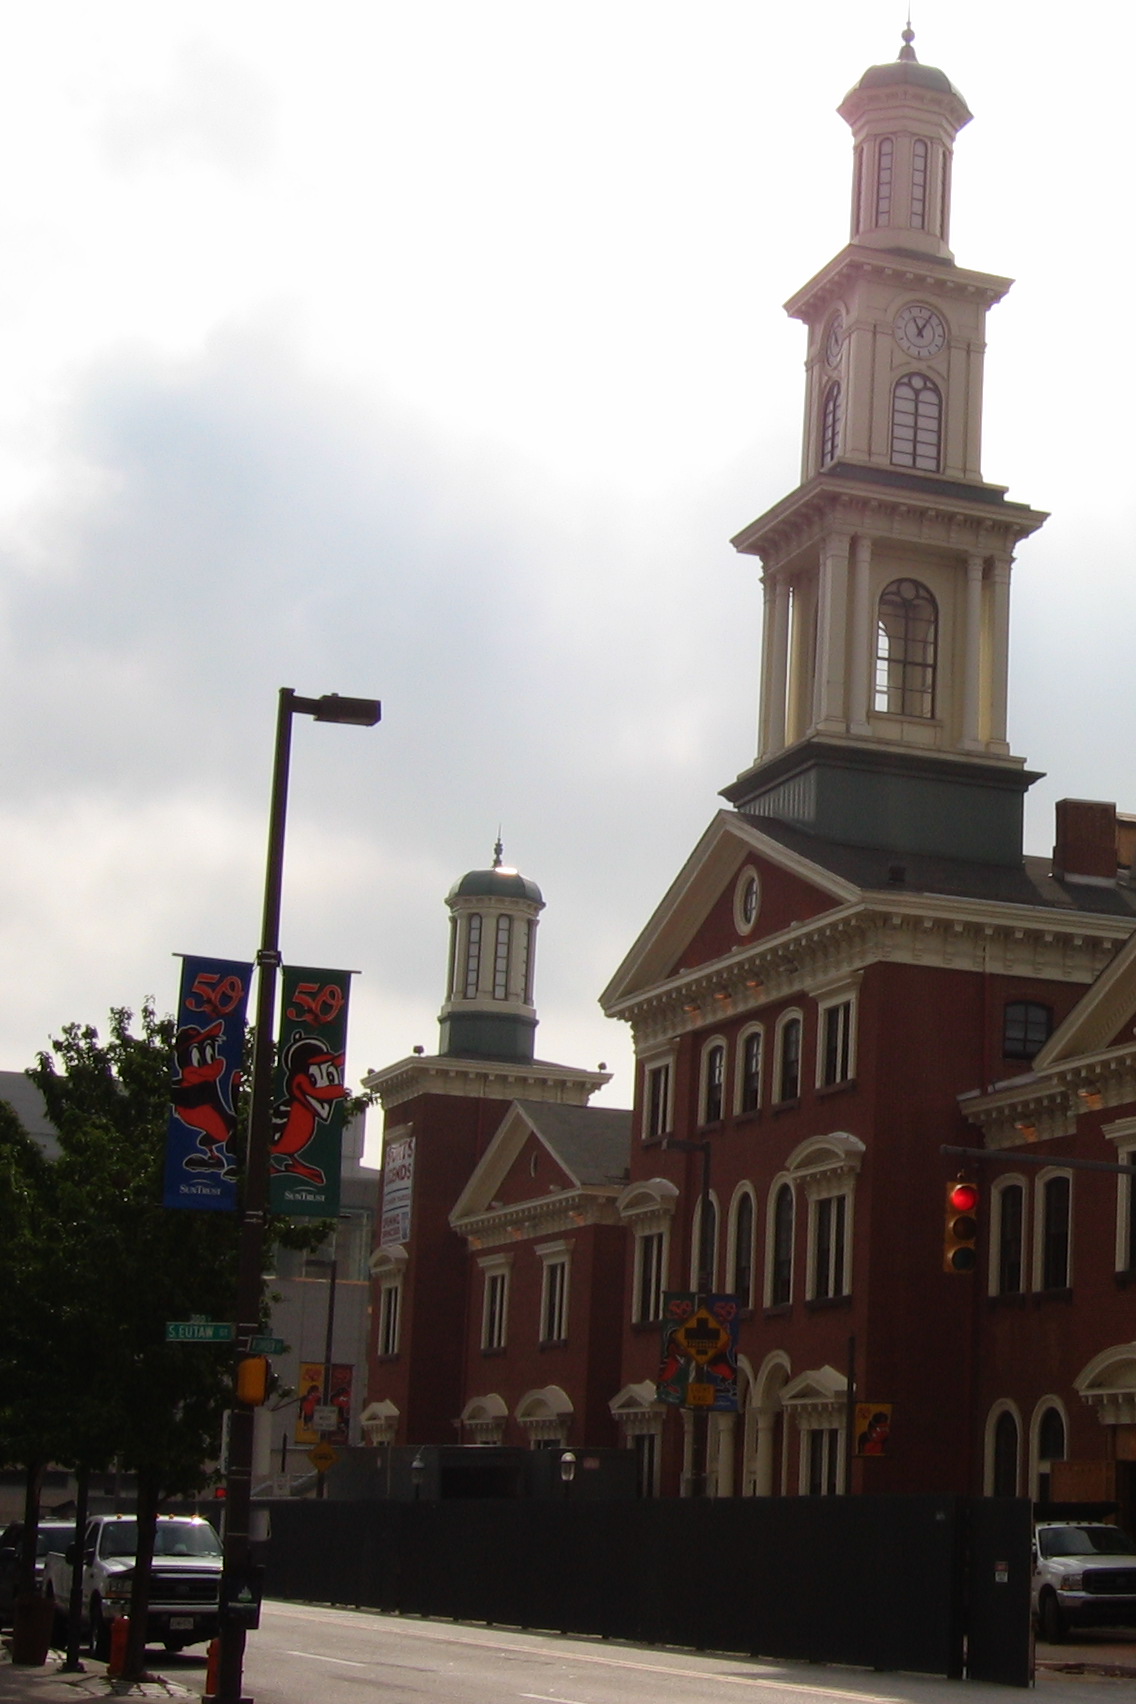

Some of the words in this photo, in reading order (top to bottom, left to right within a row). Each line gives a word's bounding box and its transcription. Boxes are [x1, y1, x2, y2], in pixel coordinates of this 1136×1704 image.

[185, 973, 244, 1015] 50
[287, 983, 344, 1023] 50
[168, 1326, 175, 1337] S
[179, 1326, 214, 1338] EUTAW
